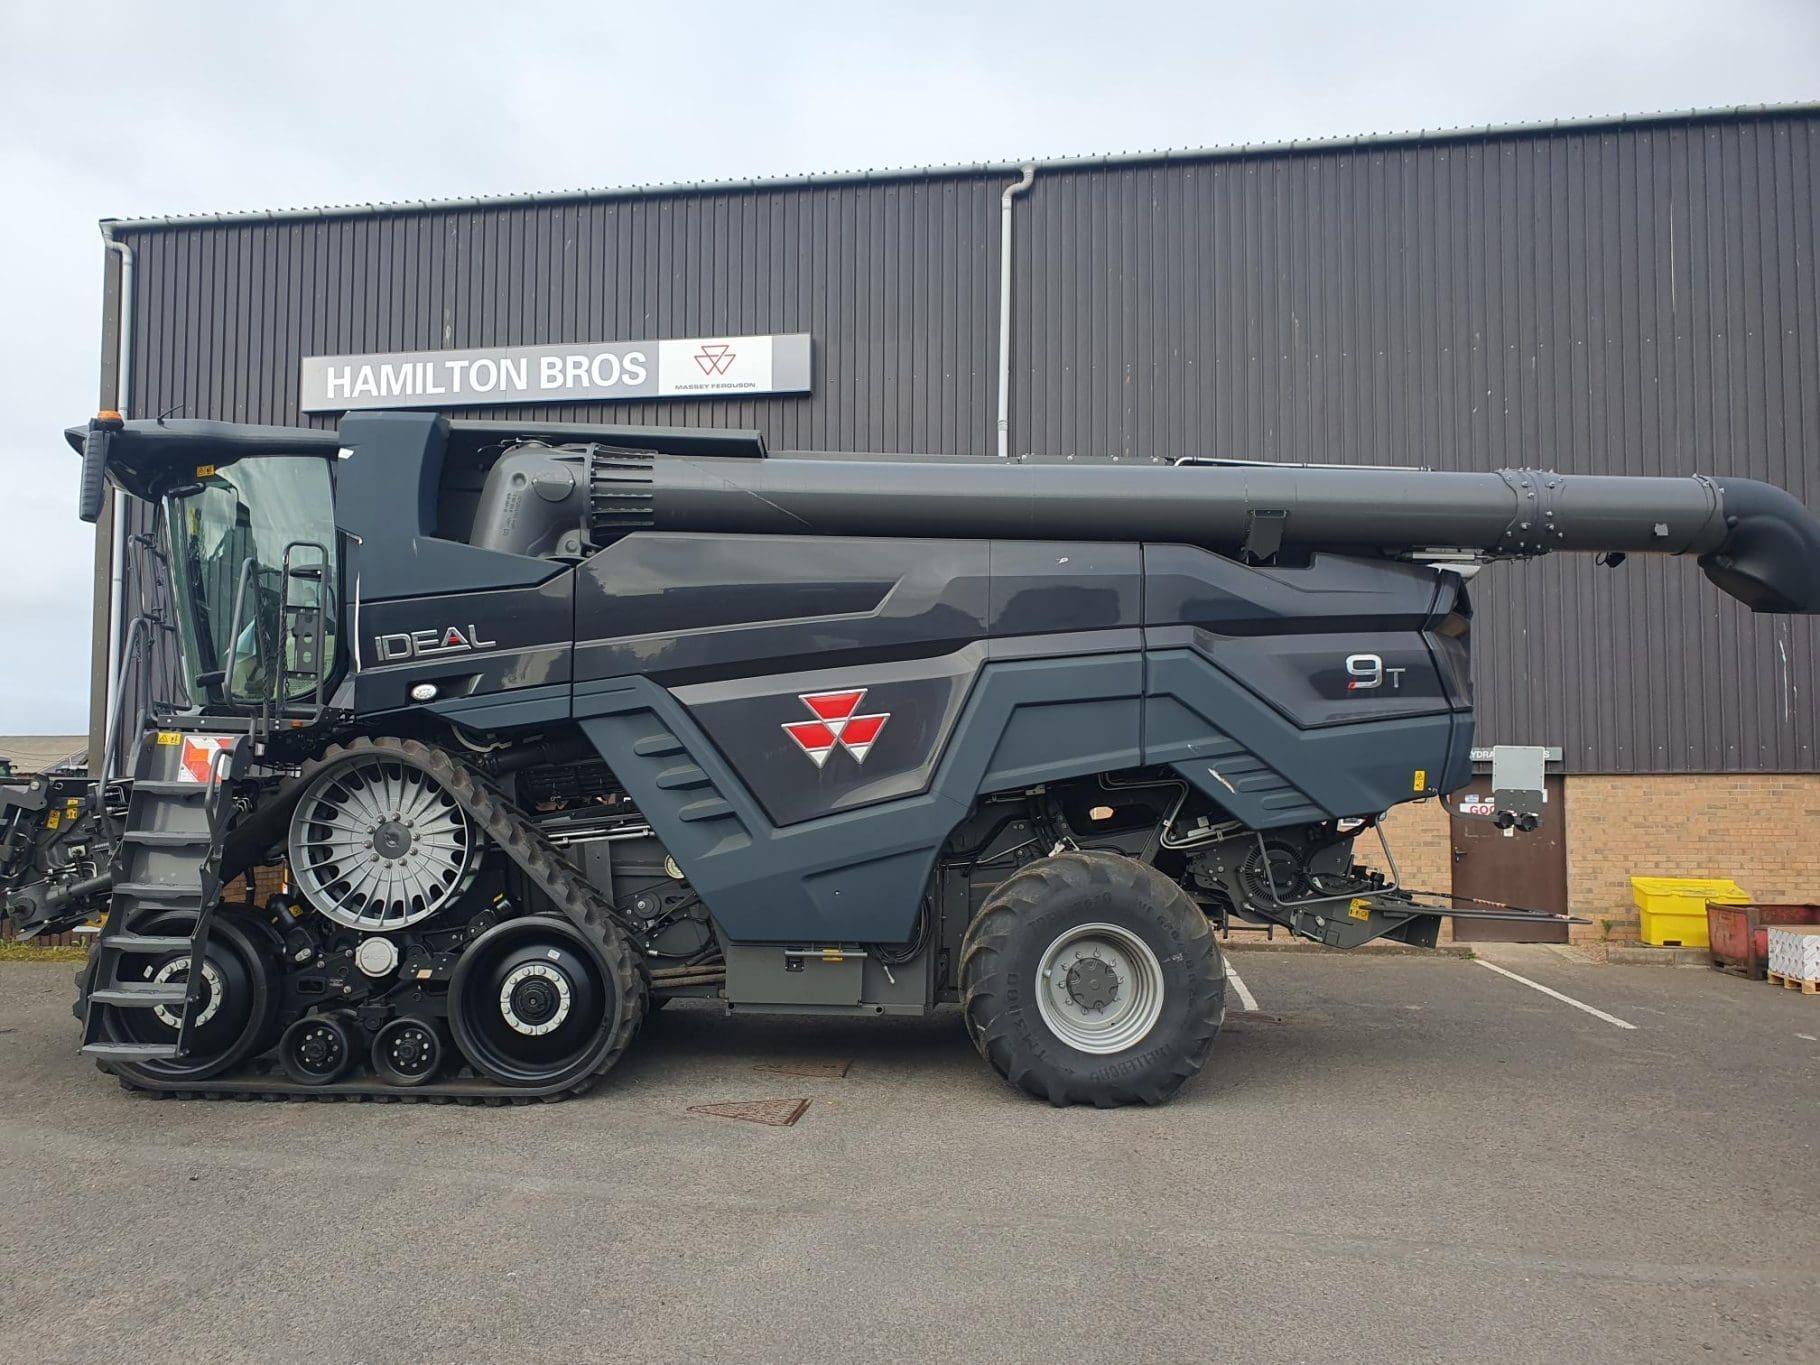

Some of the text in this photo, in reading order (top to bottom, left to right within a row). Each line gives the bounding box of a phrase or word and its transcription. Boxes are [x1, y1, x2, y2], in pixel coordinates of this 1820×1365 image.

[326, 351, 647, 399] HAMILTON BROS
[374, 624, 497, 662] IDEAL
